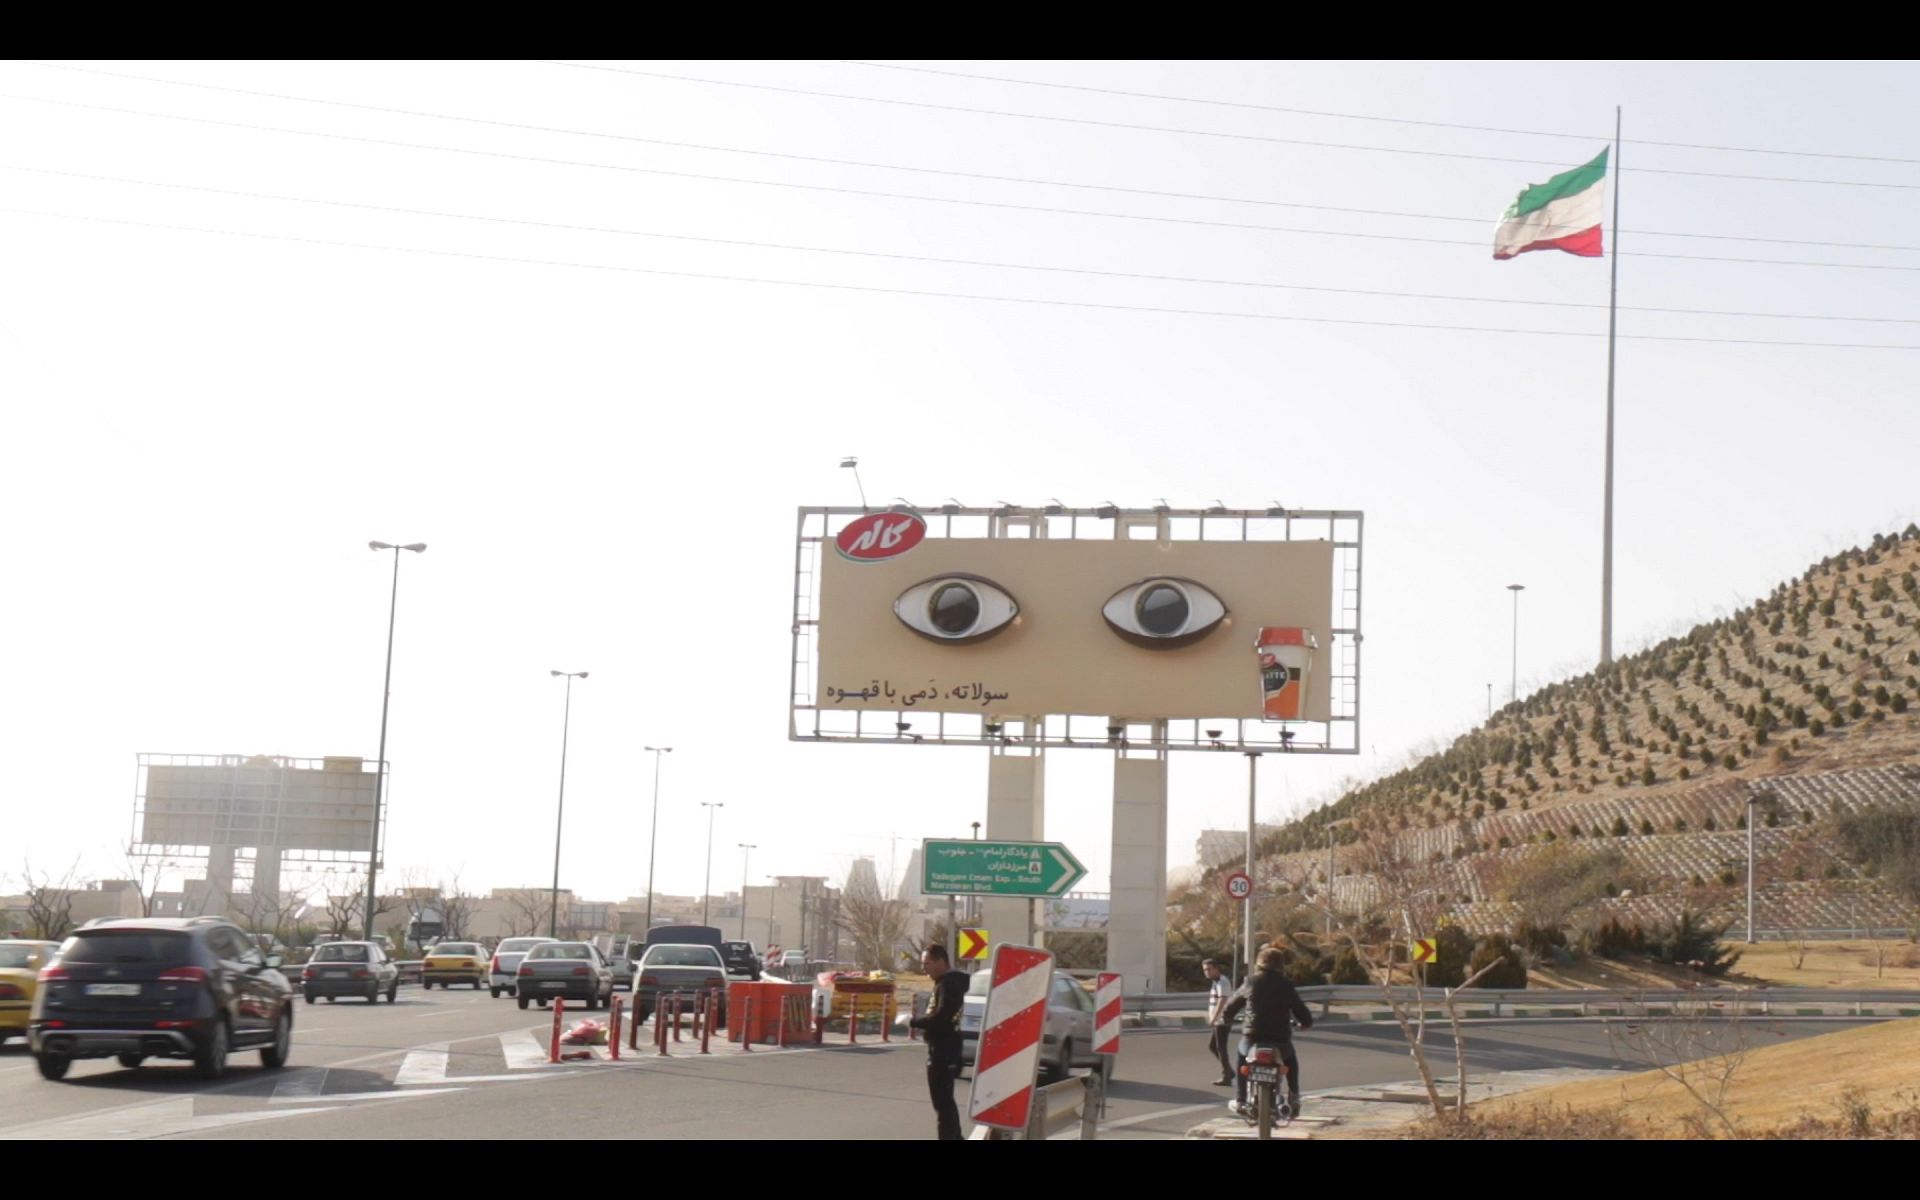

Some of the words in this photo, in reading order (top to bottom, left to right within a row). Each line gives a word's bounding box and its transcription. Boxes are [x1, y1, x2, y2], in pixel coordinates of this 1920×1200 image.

[827, 679, 880, 704] قهوه
[884, 680, 896, 704] با
[1231, 880, 1247, 893] 30
